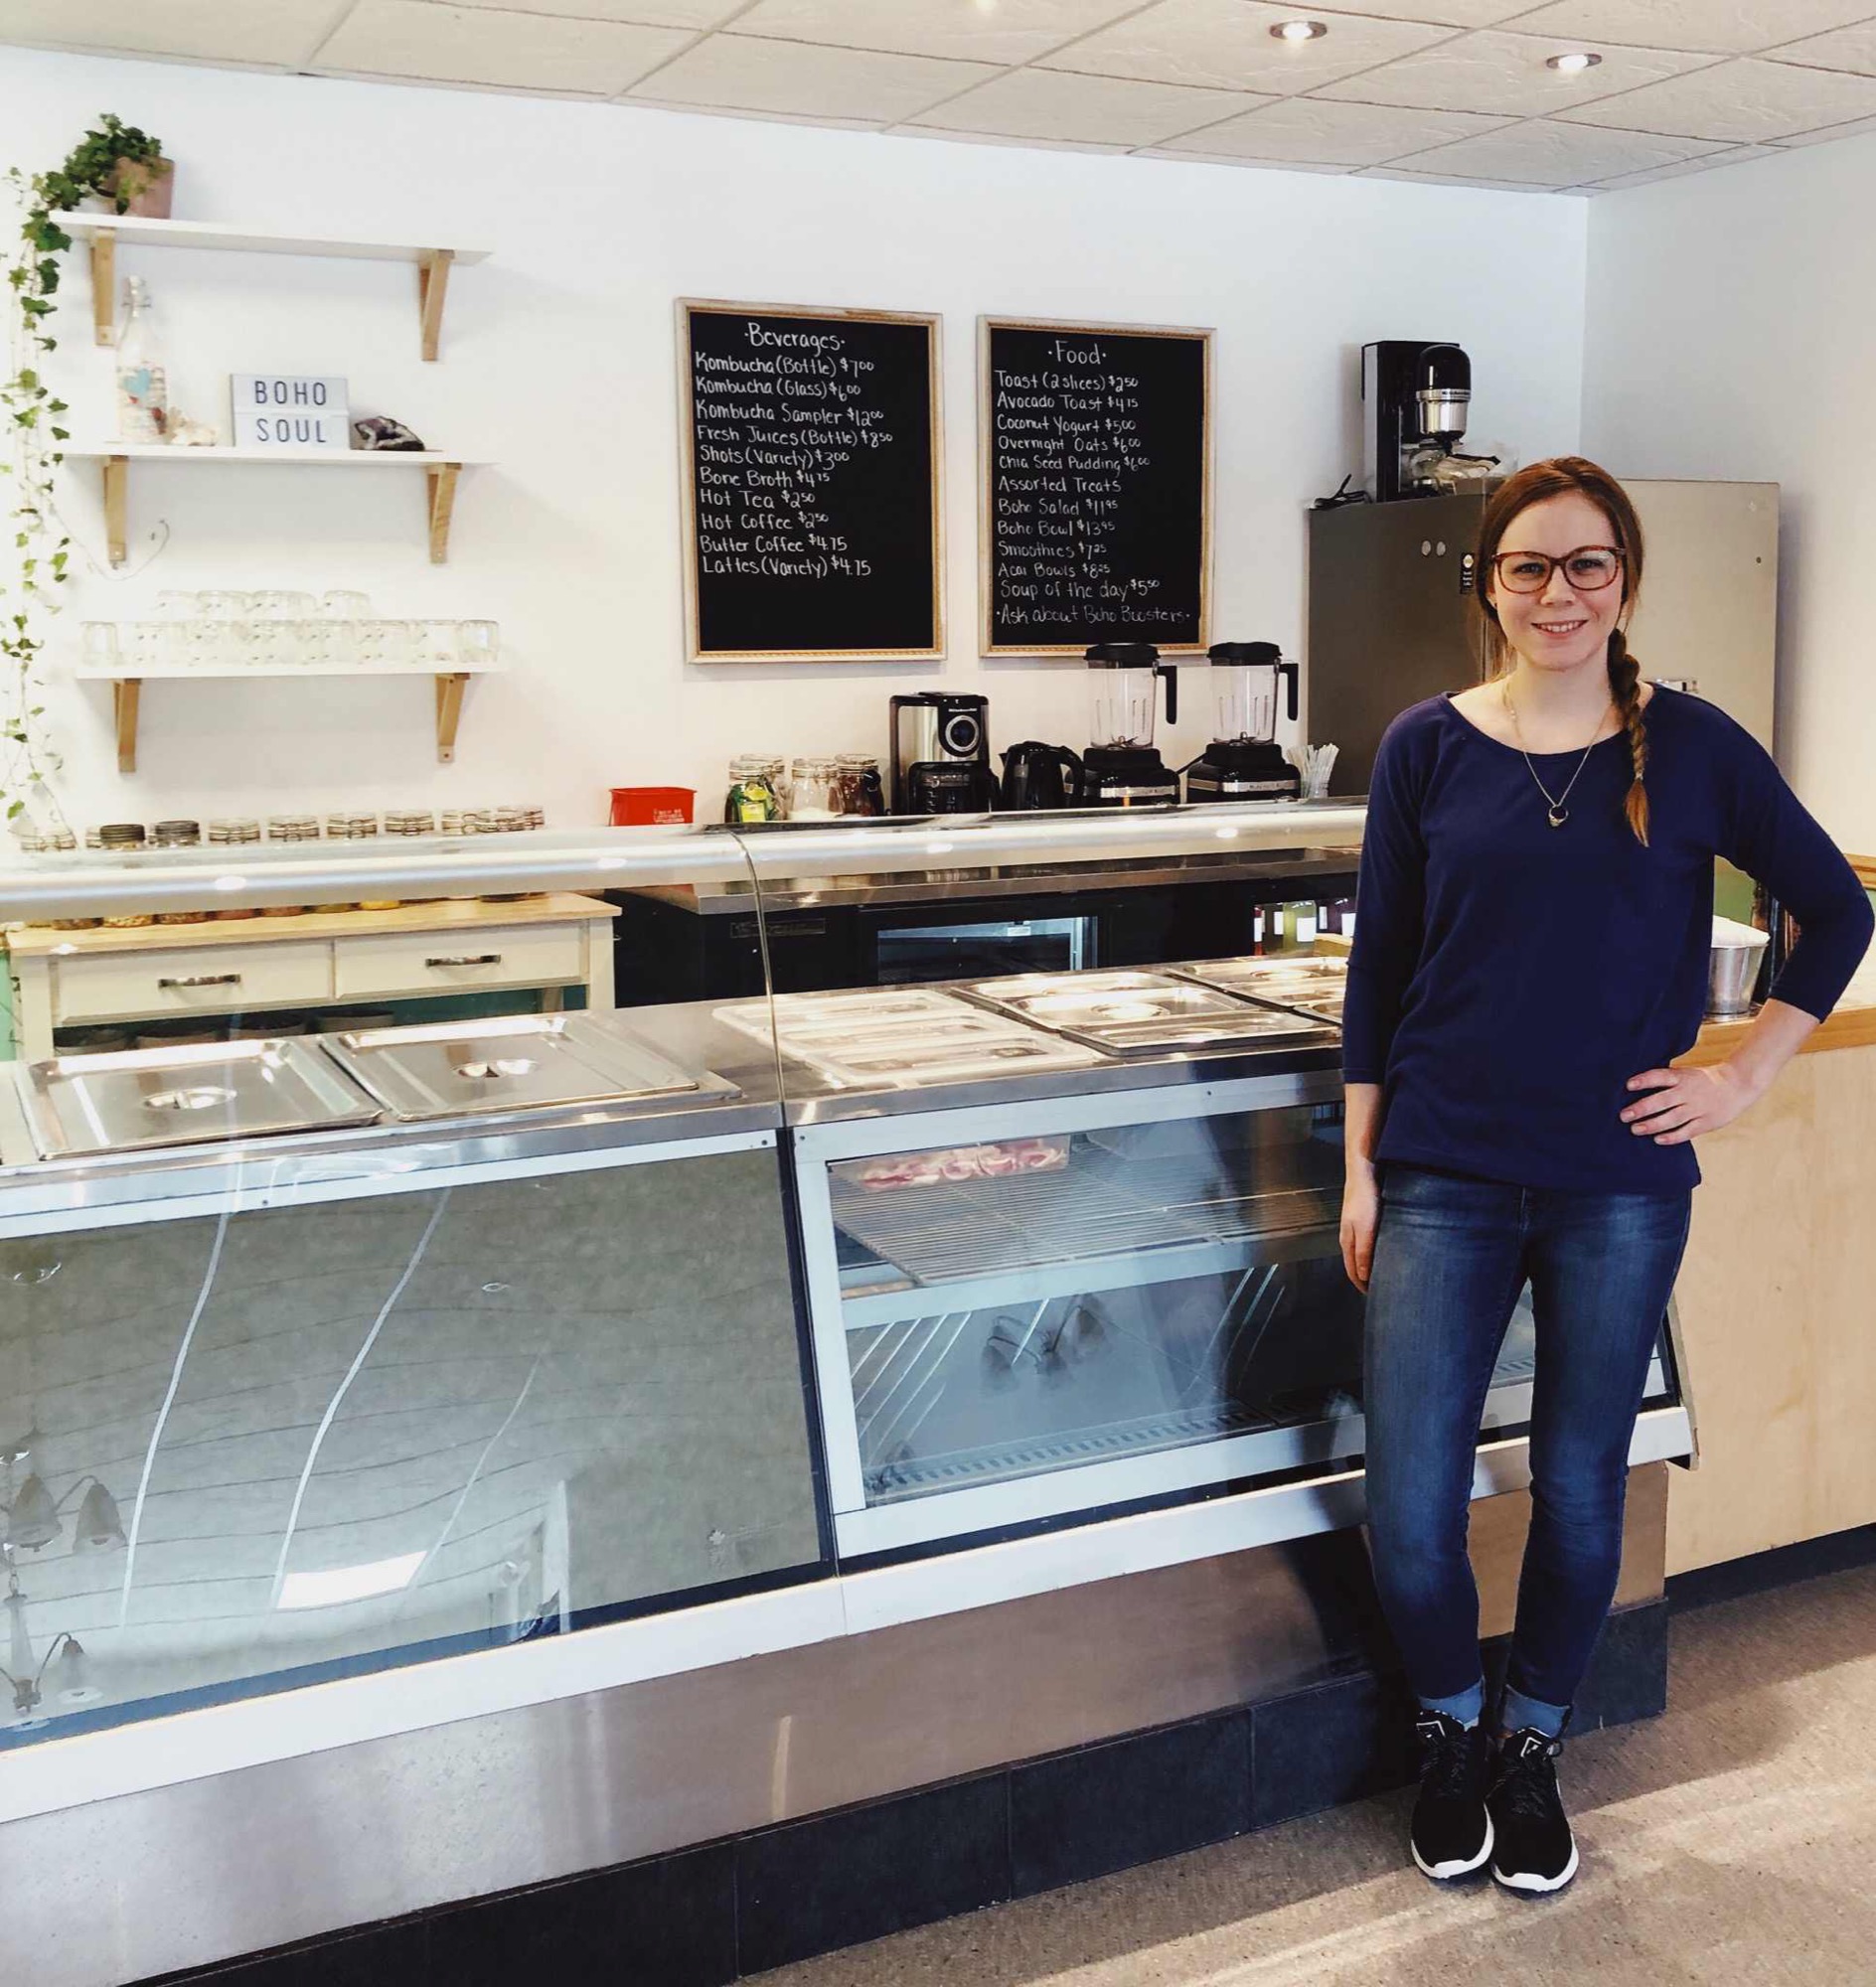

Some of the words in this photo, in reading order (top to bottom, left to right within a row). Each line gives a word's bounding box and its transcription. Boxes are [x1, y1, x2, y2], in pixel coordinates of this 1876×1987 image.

[995, 370, 1038, 388] Toast
[255, 381, 326, 405] BOHO
[997, 391, 1055, 409] Avocado
[1059, 394, 1103, 411] Toast
[696, 398, 775, 420] Kombucha
[781, 402, 843, 426] Sampler
[256, 418, 326, 442] SOUL
[697, 424, 739, 442] Fresh
[997, 413, 1049, 430] Coconut
[1053, 415, 1100, 437] Yogurt
[999, 435, 1064, 456] Overnight
[1074, 437, 1108, 452] Oats
[1000, 455, 1029, 469] Chia
[1033, 454, 1062, 470] Seed
[1068, 457, 1121, 477] Pudding
[700, 466, 741, 486] Bone
[746, 470, 793, 488] Broth
[999, 475, 1066, 493] Assorted
[1073, 477, 1122, 493] Treats
[700, 489, 731, 506] Hot
[737, 490, 775, 509] Tea
[999, 499, 1031, 516] Boho
[1038, 498, 1079, 515] Salad
[701, 513, 733, 530] Hot
[740, 514, 793, 530] Coffee
[998, 520, 1032, 535] Boho
[1038, 521, 1072, 535] Bowl
[700, 535, 749, 553] Butter
[755, 535, 805, 552] Coffee
[998, 540, 1075, 556] Smoothies
[1034, 562, 1076, 577] Bowls
[1001, 580, 1038, 600] Soup
[1044, 580, 1061, 597] of
[1067, 582, 1093, 598] the
[1100, 580, 1128, 602] day
[1032, 605, 1077, 623] about
[1084, 605, 1117, 624] Boho
